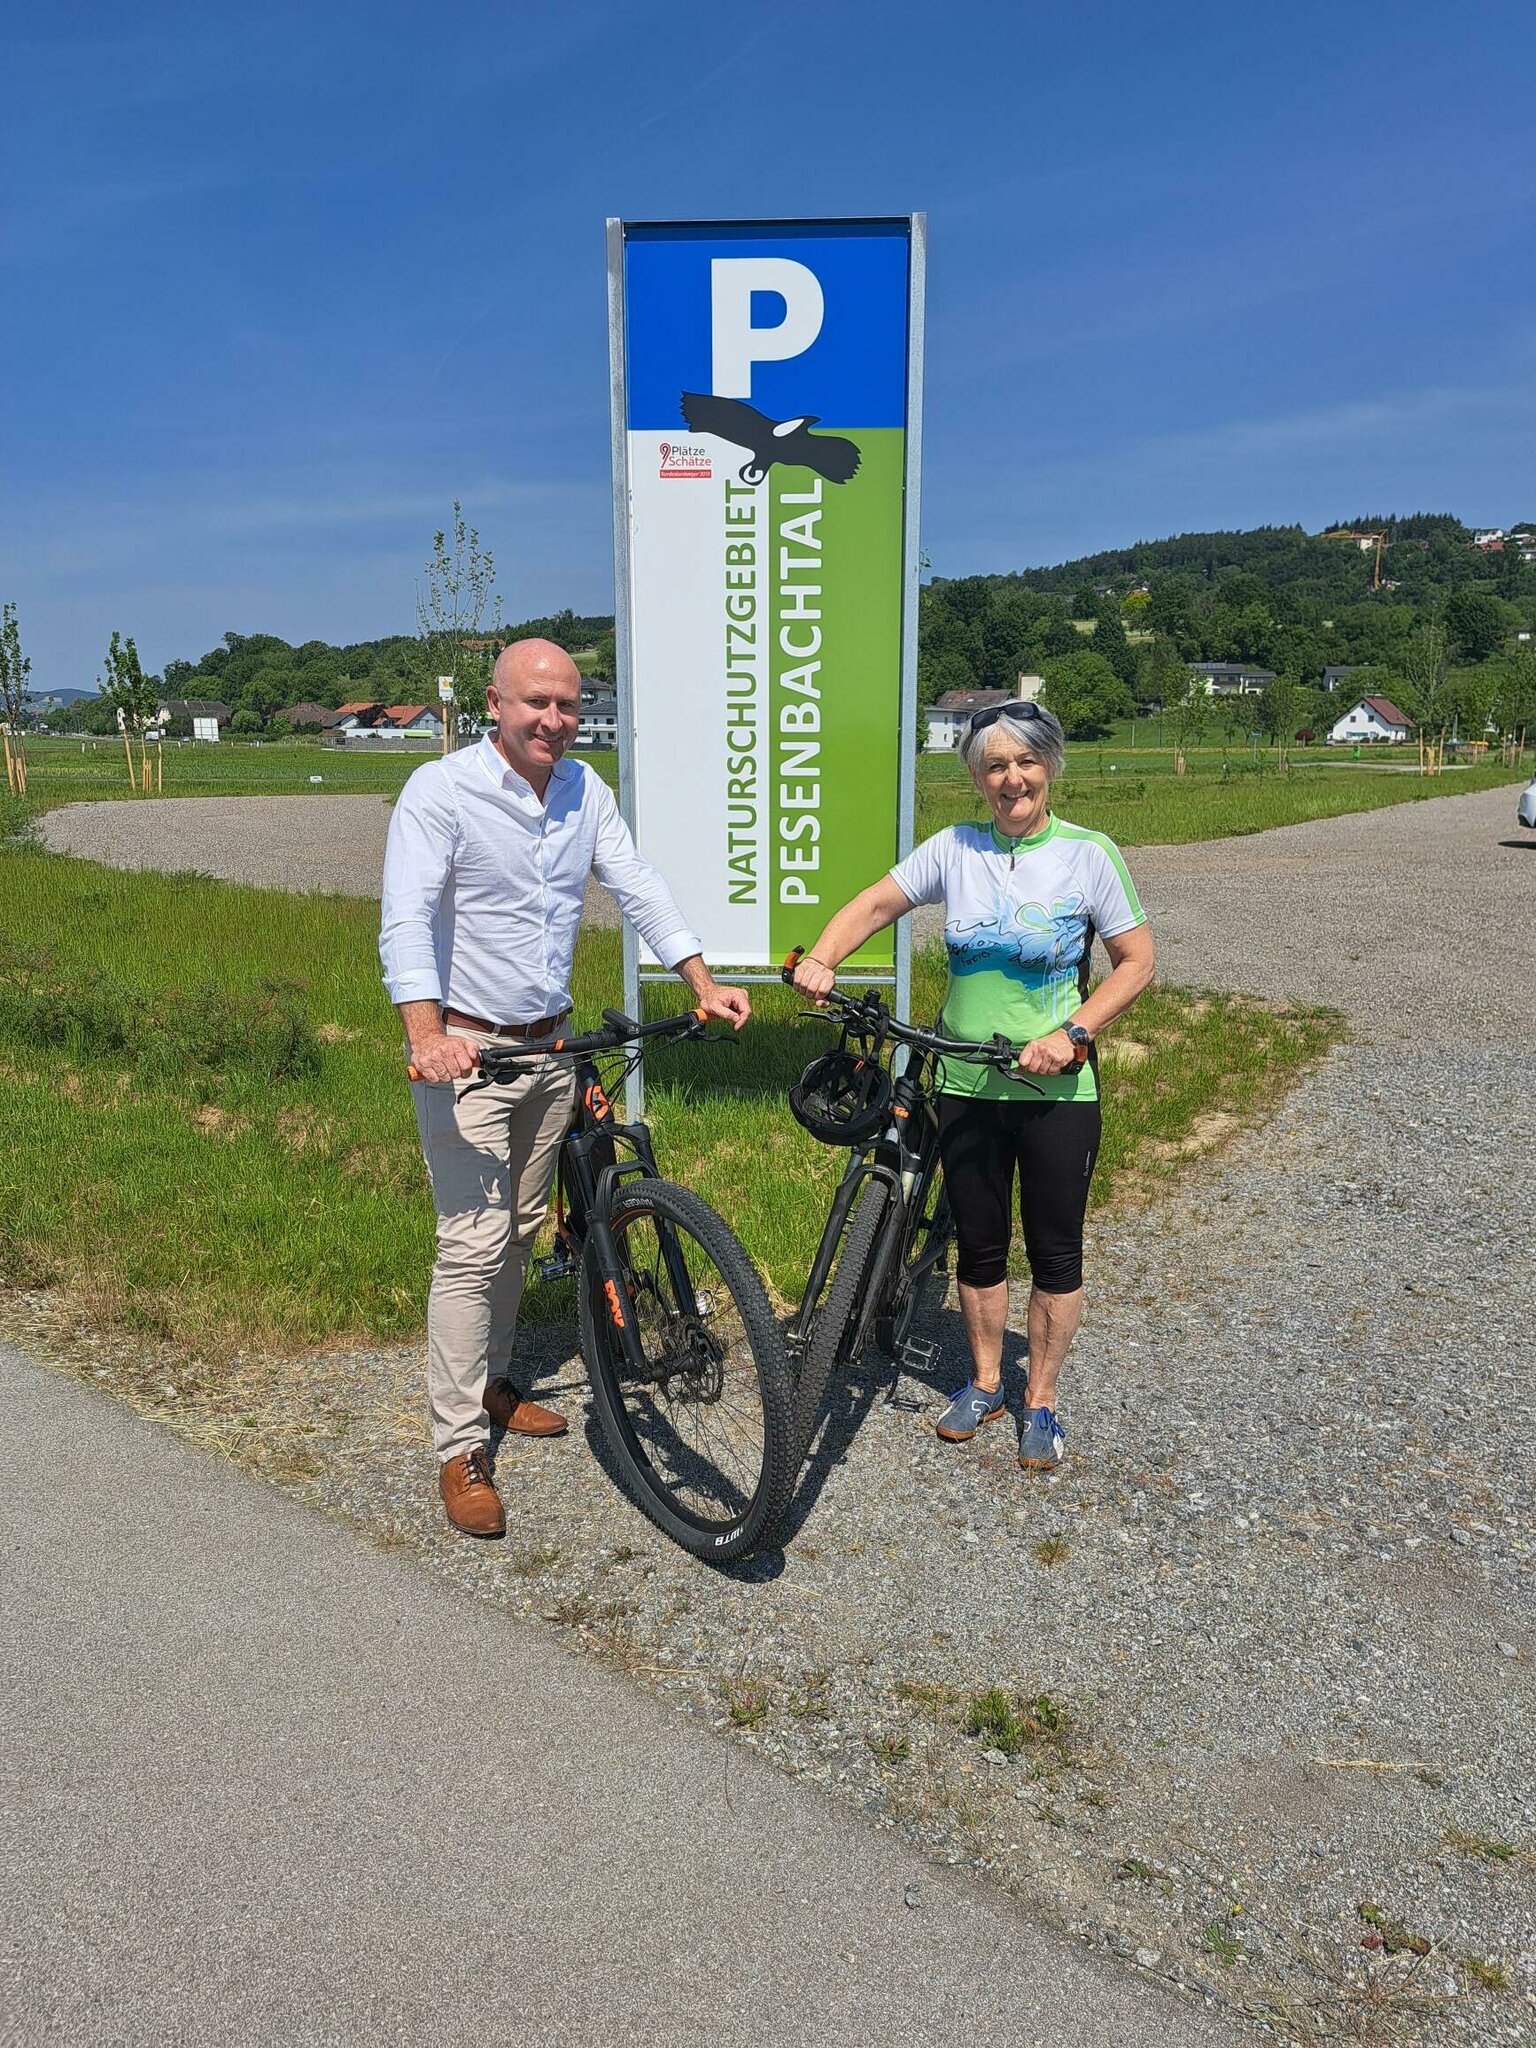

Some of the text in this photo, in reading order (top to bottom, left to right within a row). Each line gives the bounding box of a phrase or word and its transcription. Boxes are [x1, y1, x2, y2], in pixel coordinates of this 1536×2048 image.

[711, 258, 824, 399] P
[669, 456, 712, 466] Schätze
[672, 446, 705, 456] Plätze
[726, 479, 757, 905] NATURSCHUTZGEBIET
[778, 478, 824, 905] PESENBACHTAL
[715, 1528, 740, 1546] WTB
